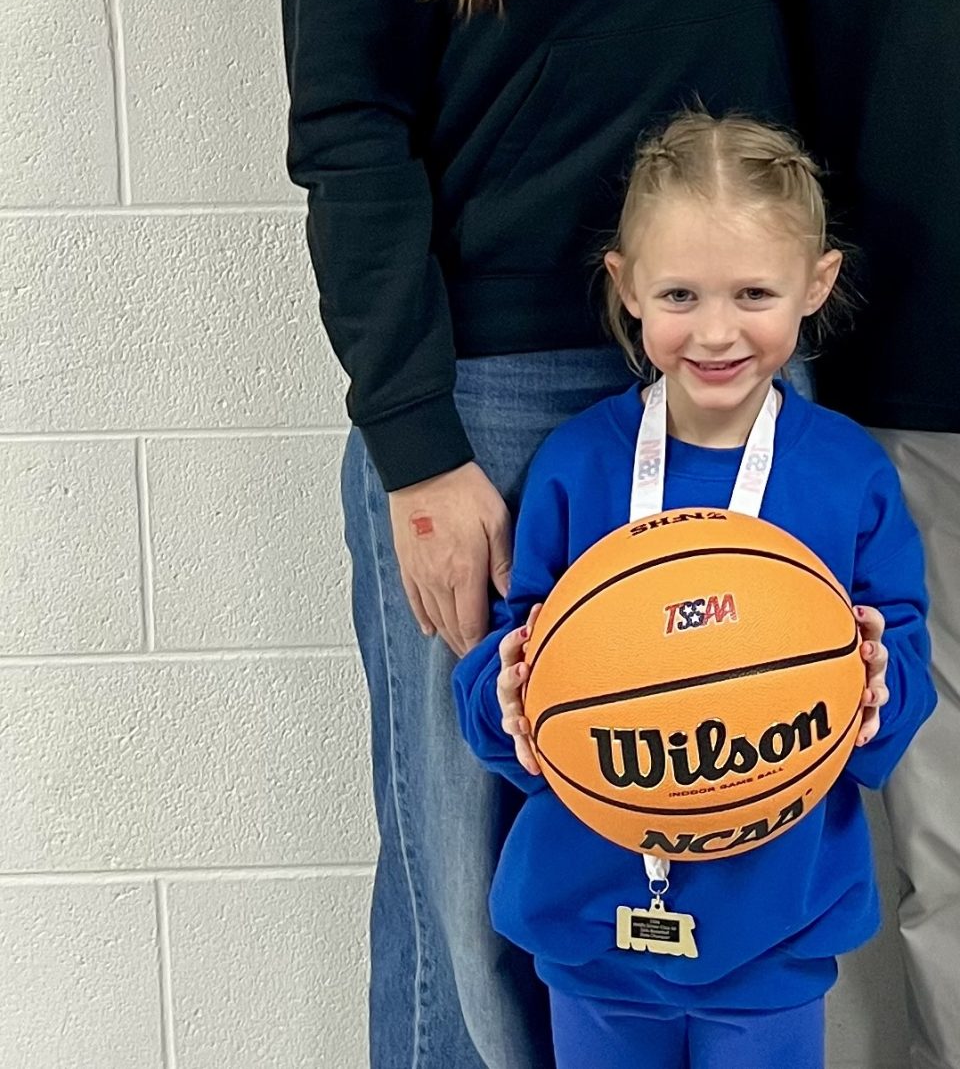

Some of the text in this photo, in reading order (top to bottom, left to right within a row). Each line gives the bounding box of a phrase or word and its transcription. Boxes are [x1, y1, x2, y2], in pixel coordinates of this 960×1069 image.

[664, 593, 738, 634] TSSAA
[590, 701, 832, 789] Wilson
[669, 767, 784, 798] INDOOR GAME BALL
[640, 796, 804, 854] NCAA
